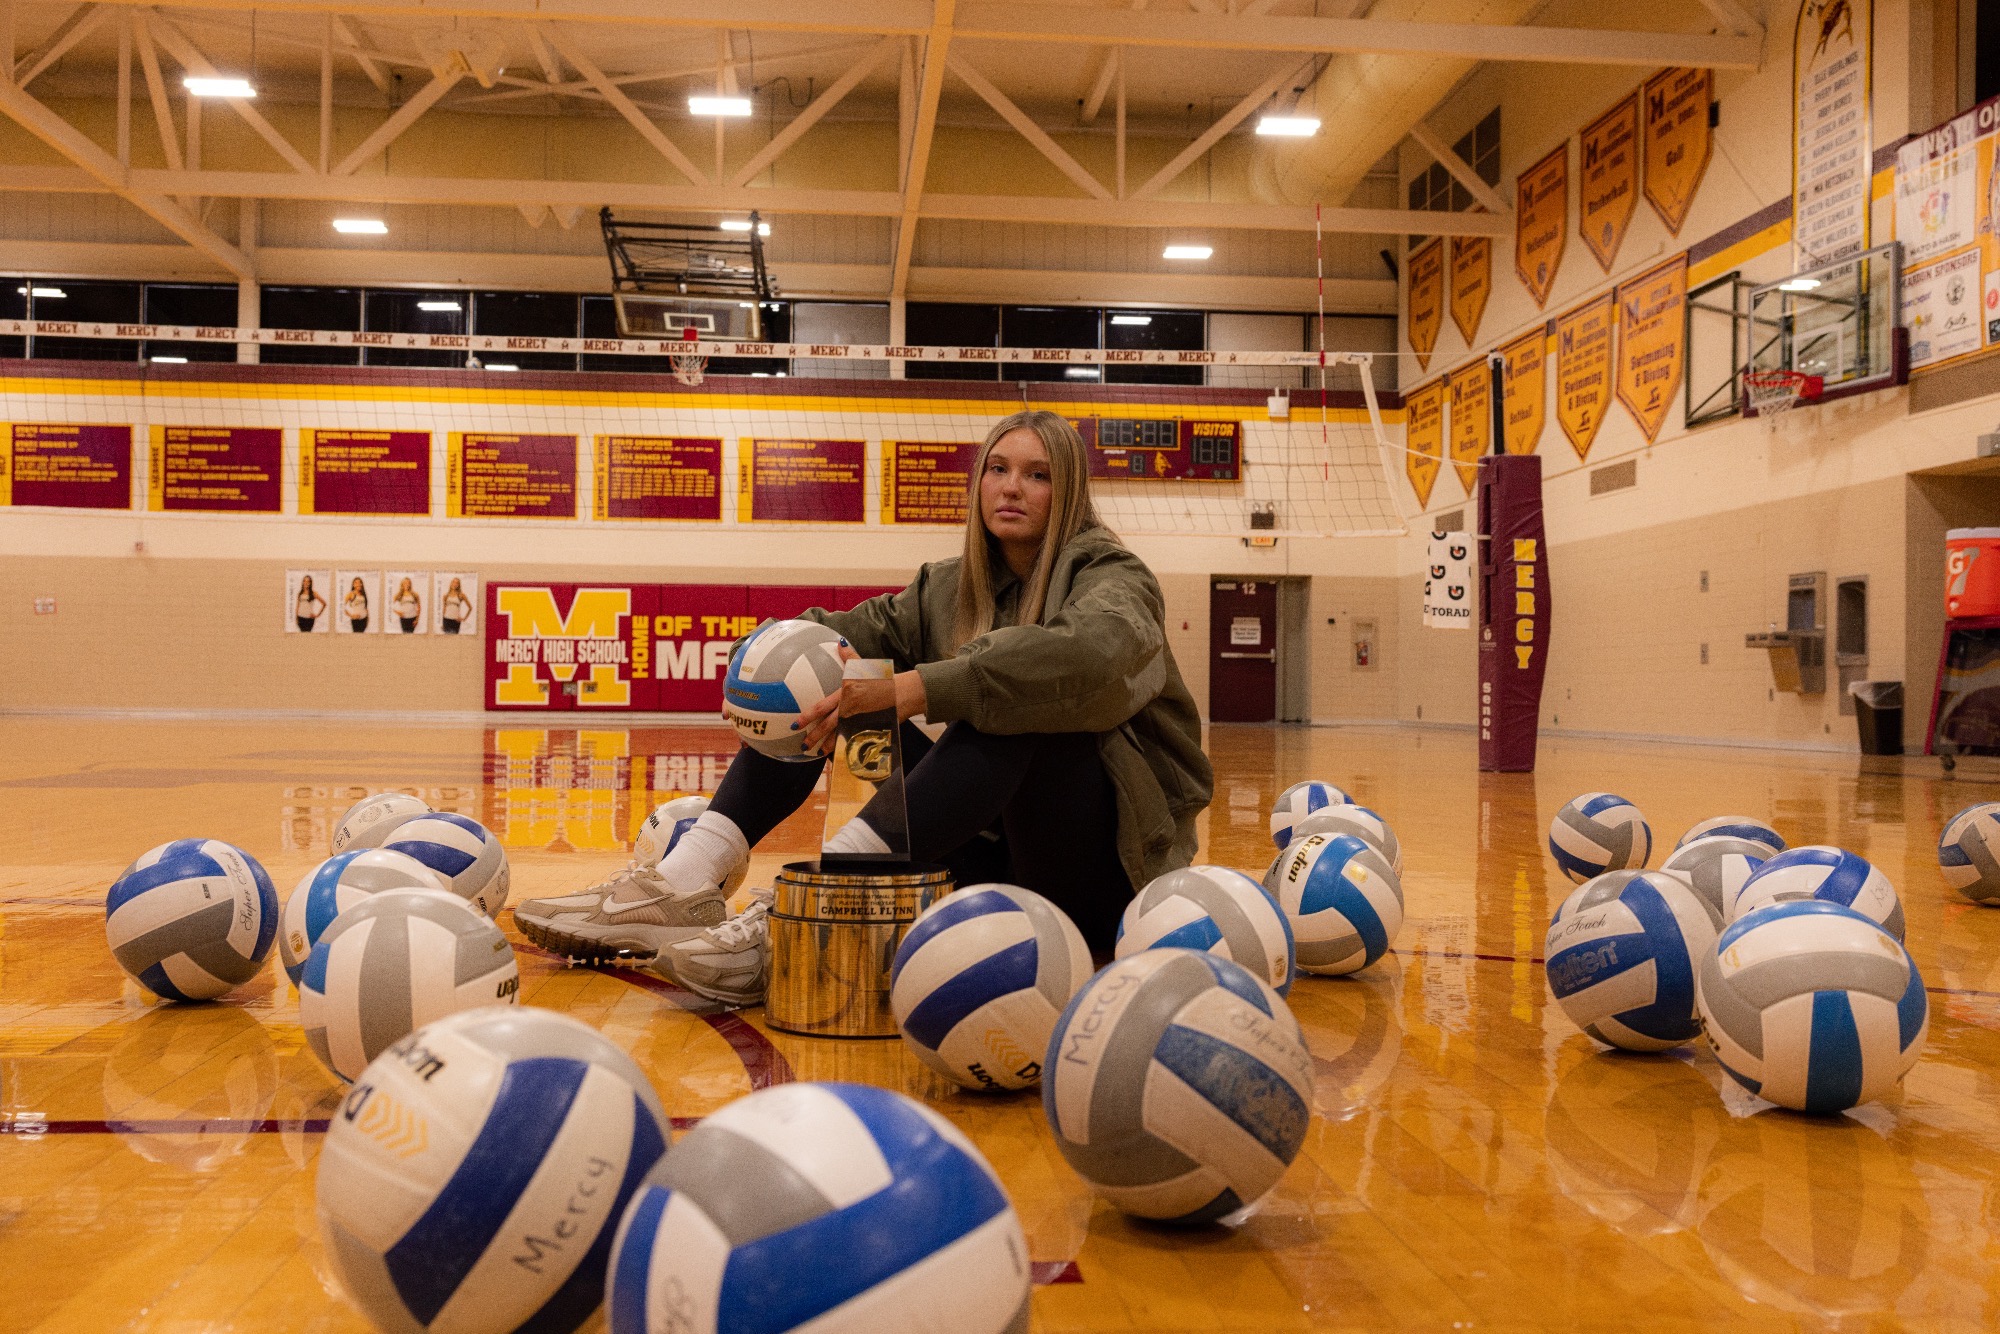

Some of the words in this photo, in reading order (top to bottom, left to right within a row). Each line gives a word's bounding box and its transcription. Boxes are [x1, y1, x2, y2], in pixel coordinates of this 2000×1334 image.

[37, 322, 78, 334] MERCY
[116, 325, 158, 337] MERCY
[196, 327, 237, 339] MERCY
[275, 330, 315, 342] MERCY
[352, 333, 393, 344] MERCY
[430, 336, 470, 347] MERCY
[507, 337, 547, 349] MERCY
[583, 340, 624, 351] MERCY
[660, 342, 699, 353] MERCY
[735, 343, 775, 355] MERCY
[811, 345, 849, 356] MERCY
[885, 346, 924, 358] MERCY
[959, 348, 997, 360] MERCY
[1033, 349, 1071, 361] MERCY
[1106, 350, 1144, 362] MERCY
[1178, 351, 1216, 363] MERCY
[1193, 422, 1234, 437] VISITOR
[1450, 545, 1467, 561] G
[1949, 551, 1966, 575] G
[1430, 565, 1446, 580] G
[1242, 582, 1257, 596] 12
[1448, 585, 1465, 600] G
[1431, 607, 1471, 618] TORAD
[1513, 538, 1537, 669] MERCY
[655, 616, 693, 637] OF
[701, 616, 758, 637] THE
[496, 639, 540, 663] MERCY
[543, 639, 575, 663] HIGH
[578, 640, 629, 664] SCHOOL
[632, 615, 649, 679] HOME
[1482, 682, 1492, 740] Senoh
[1288, 835, 1326, 884] Baden
[240, 890, 257, 931] Super
[821, 906, 877, 915] CAMPBELL
[879, 906, 914, 915] FLYNN
[1566, 913, 1607, 936] Touch
[1063, 972, 1142, 1066] Mercy
[511, 1155, 617, 1275] Mercy
